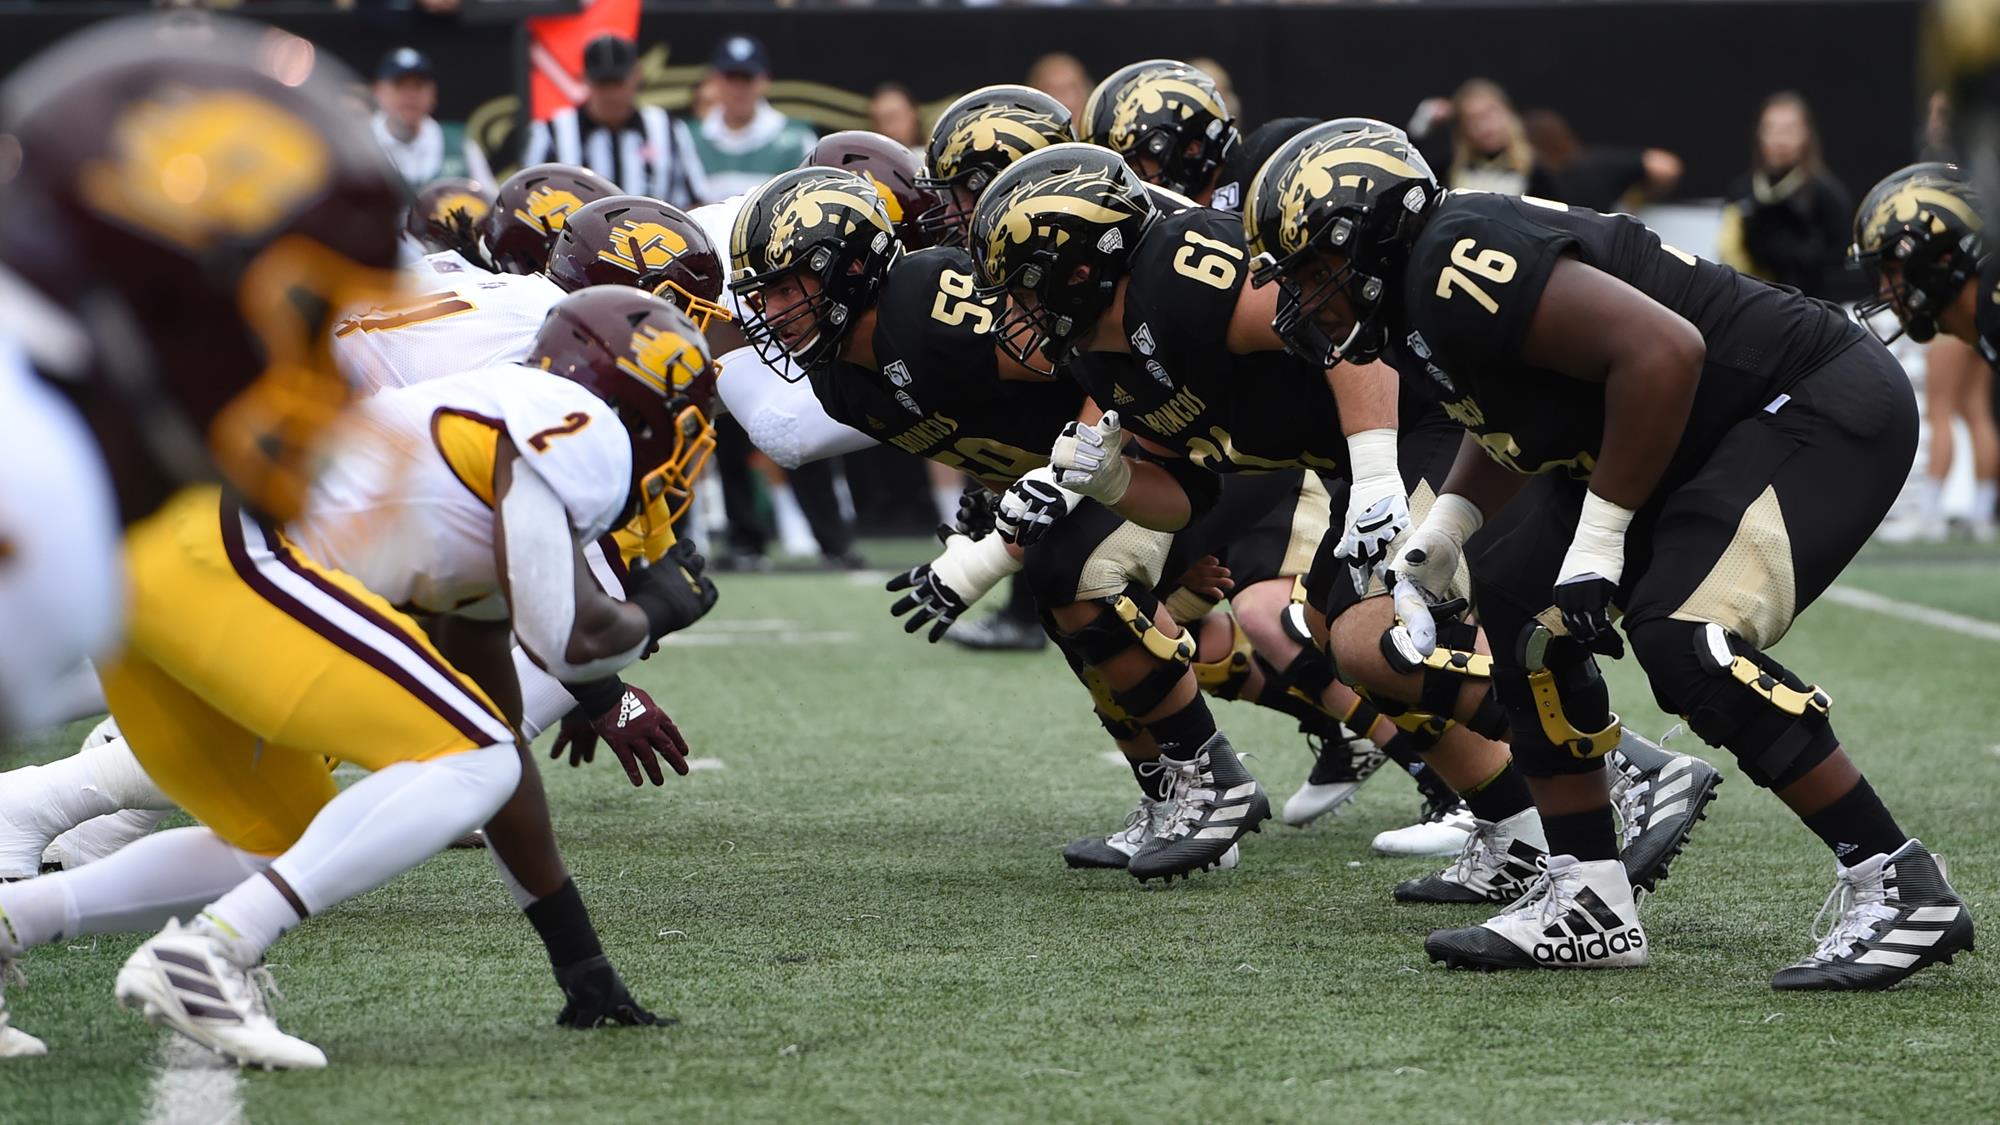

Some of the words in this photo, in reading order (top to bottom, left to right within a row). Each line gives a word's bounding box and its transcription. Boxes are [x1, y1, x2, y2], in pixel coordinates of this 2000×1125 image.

[1173, 230, 1244, 290] 61
[1435, 238, 1518, 314] 76
[527, 411, 592, 455] 2
[1533, 928, 1643, 963] adidas
